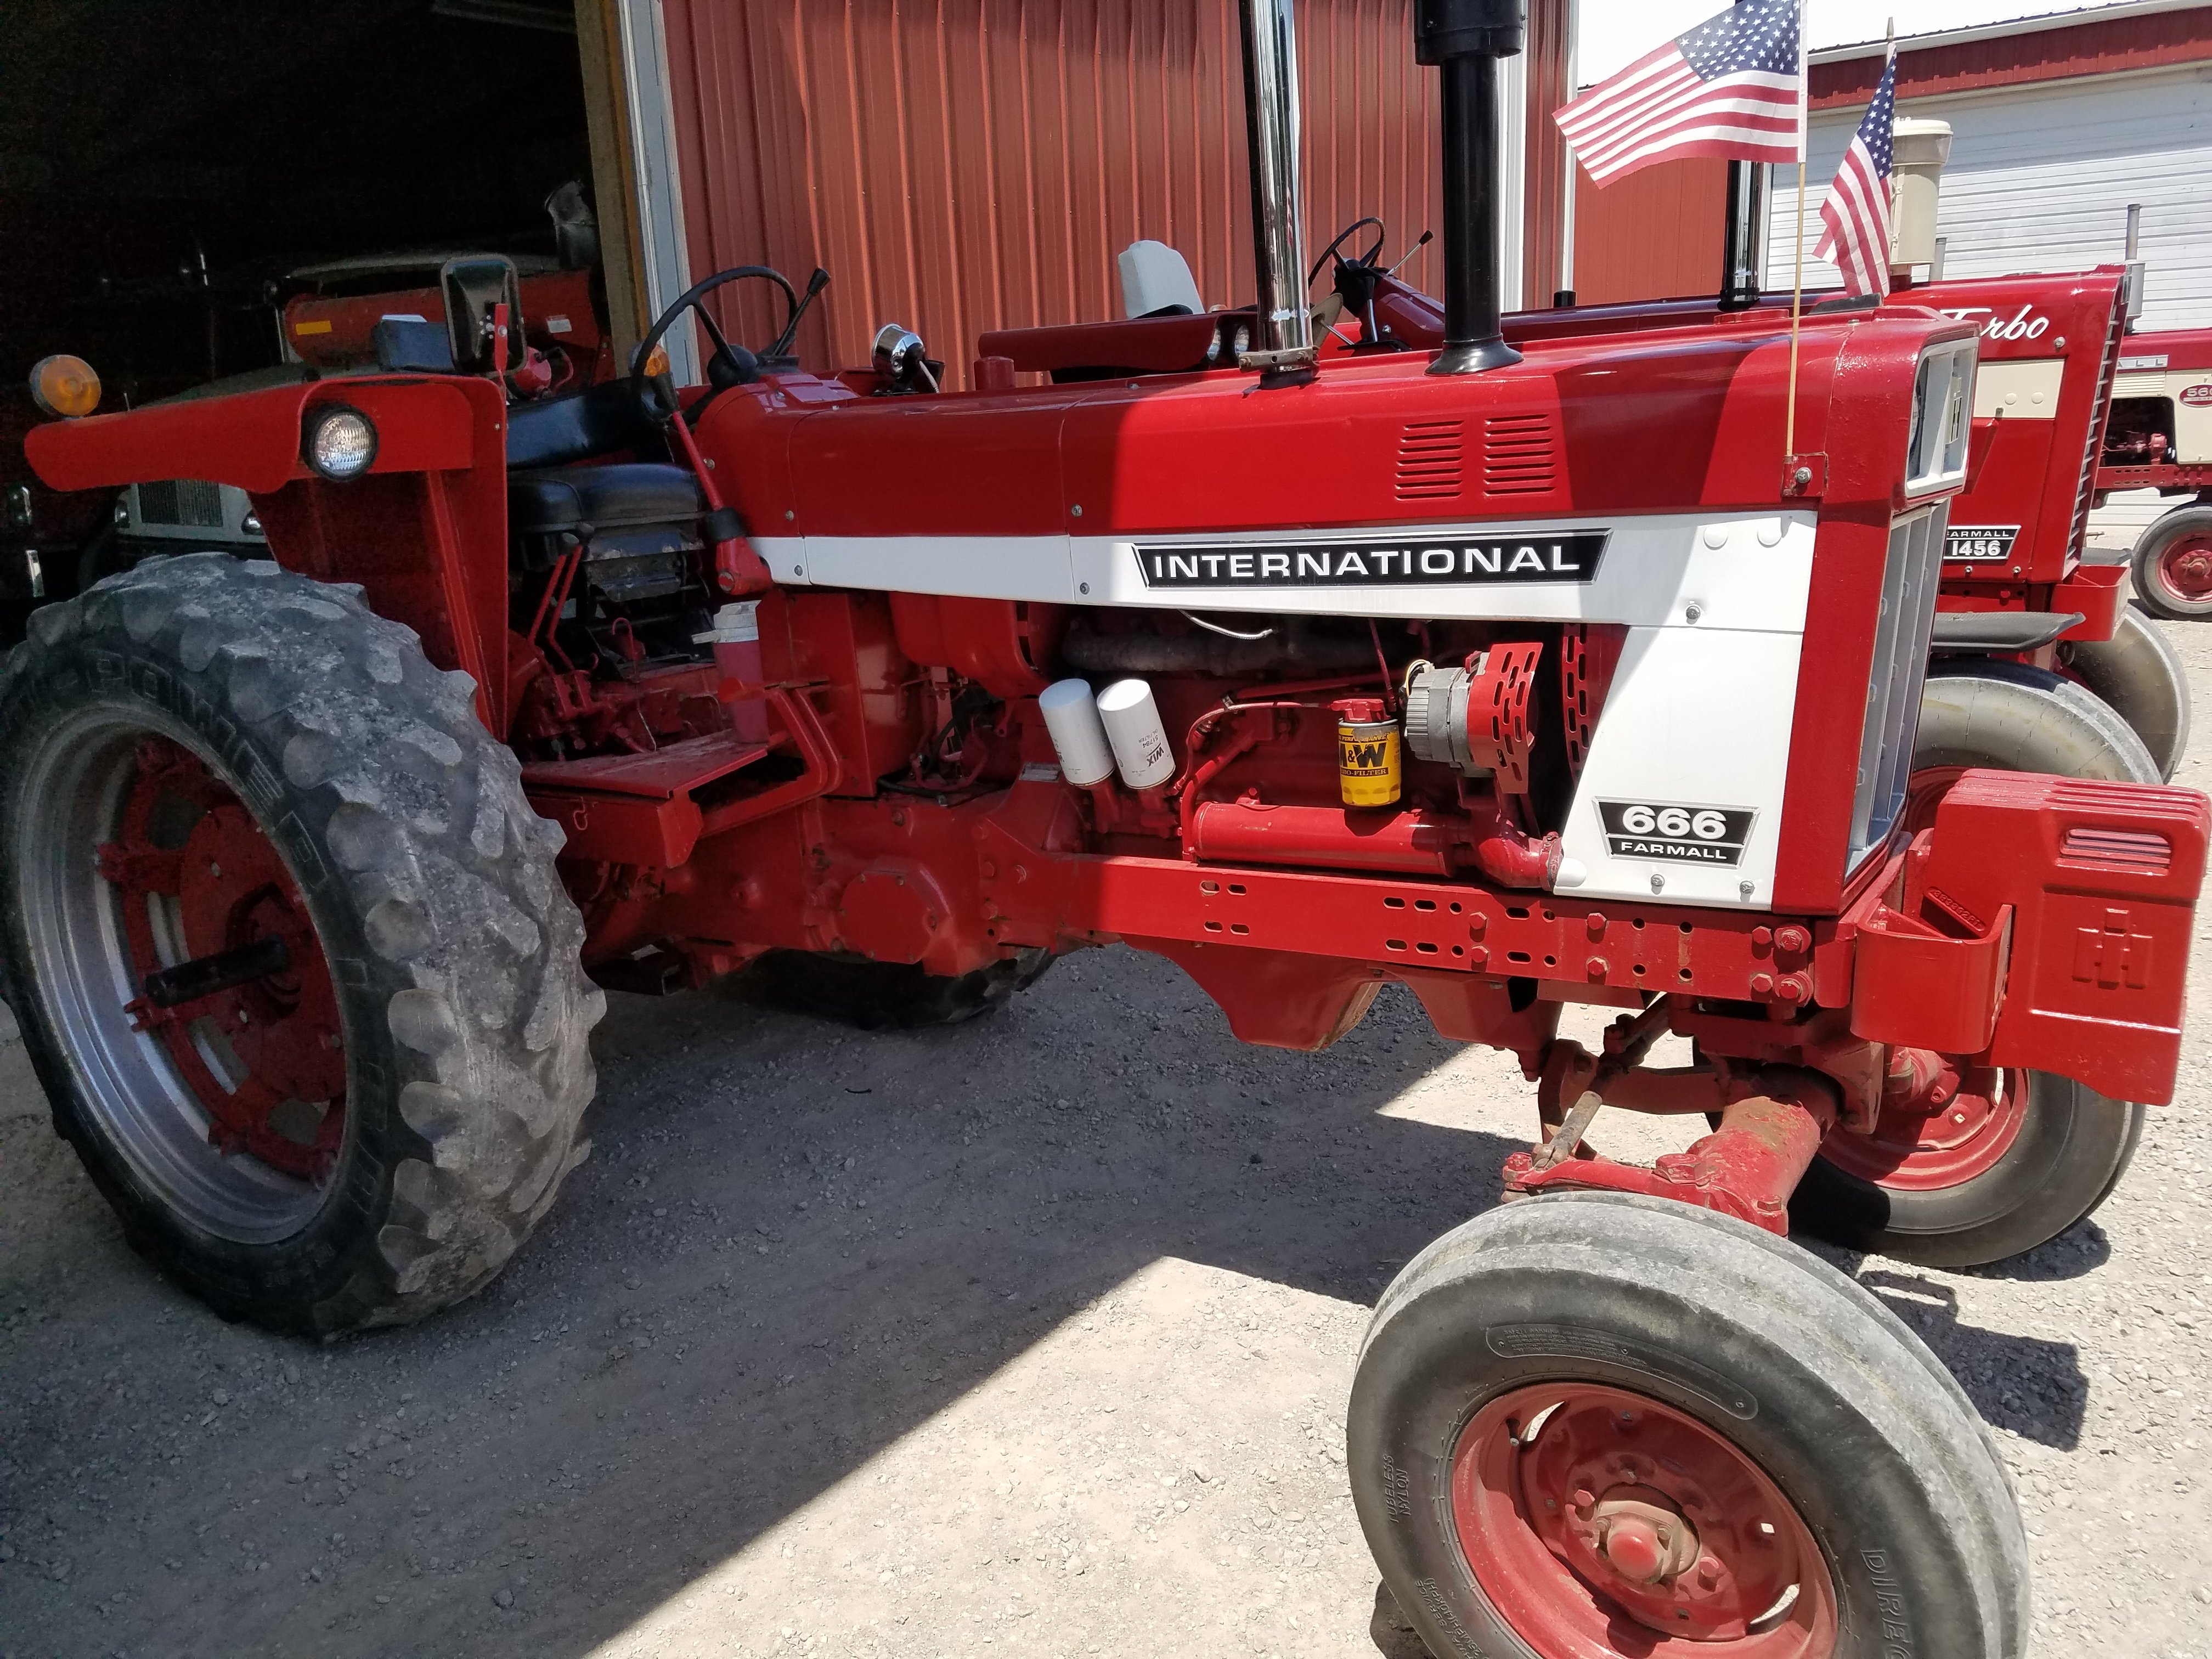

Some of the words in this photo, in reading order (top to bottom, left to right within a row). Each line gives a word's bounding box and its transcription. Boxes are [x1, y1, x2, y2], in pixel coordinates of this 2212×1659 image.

[1939, 304, 2050, 340] Trbo
[1155, 545, 1581, 579] INTERNATIONAL
[1952, 540, 2001, 556] 1456
[1142, 735, 1158, 748] 51784
[1146, 746, 1165, 768] WIX
[1622, 805, 1727, 840] 666
[1621, 842, 1727, 860] FARMALL
[1383, 1454, 1400, 1523] TUBELESS
[1395, 1468, 1412, 1516] NYLON
[1414, 1579, 1448, 1628] SERVICE
